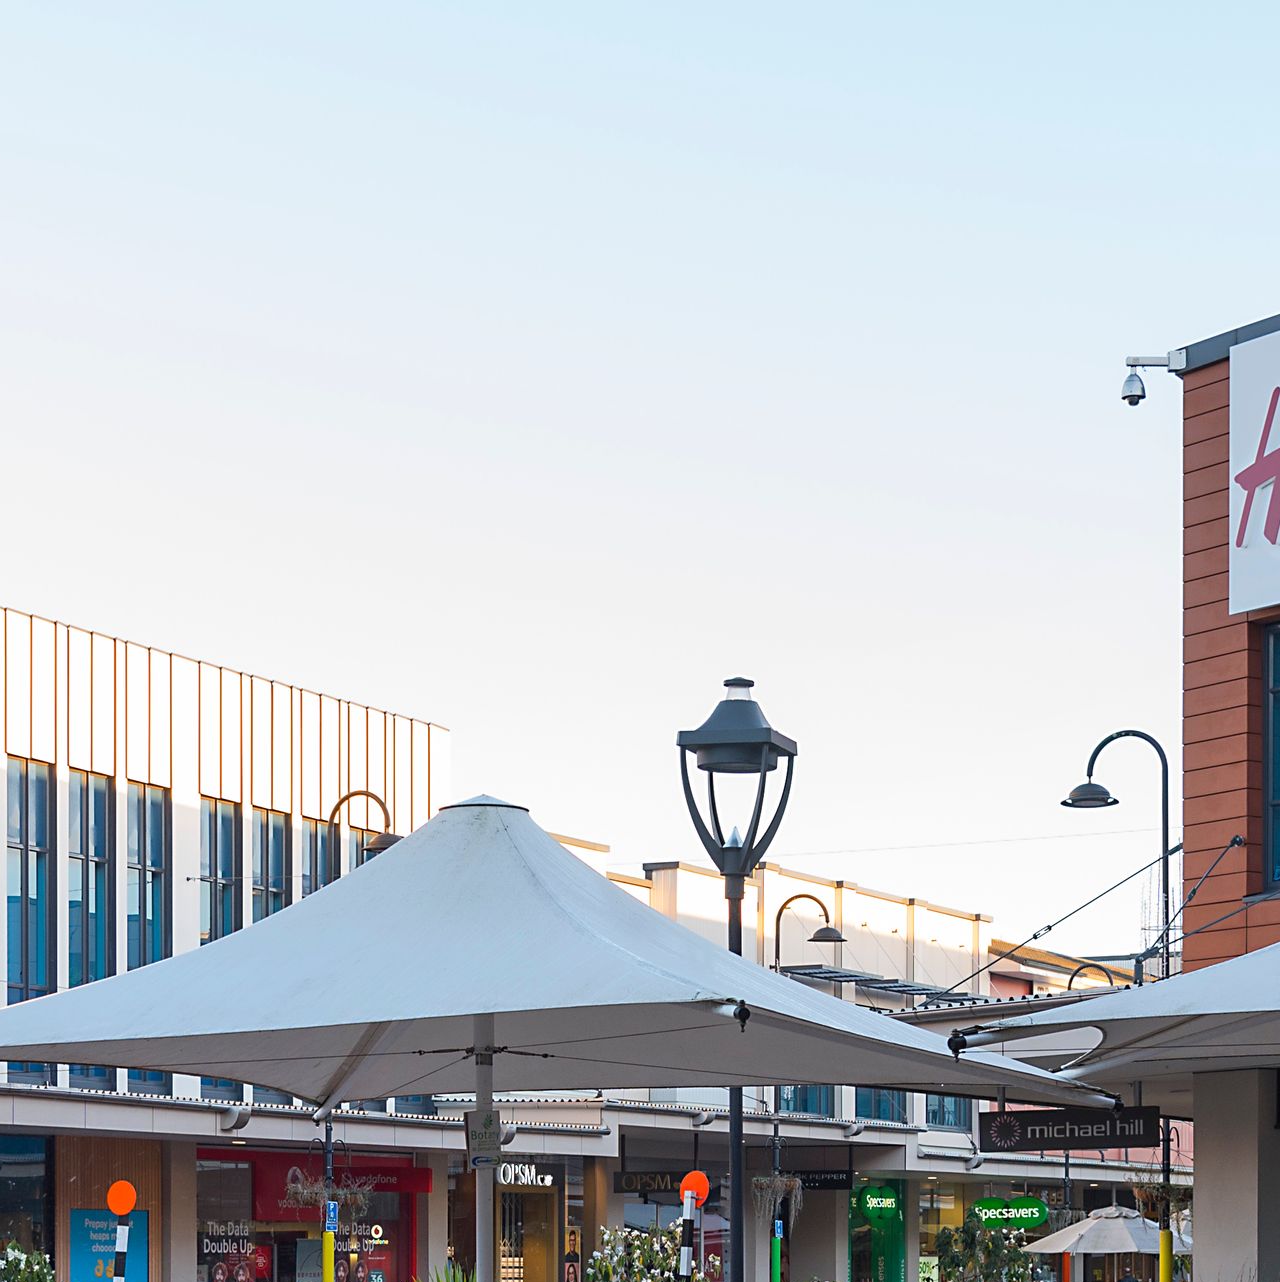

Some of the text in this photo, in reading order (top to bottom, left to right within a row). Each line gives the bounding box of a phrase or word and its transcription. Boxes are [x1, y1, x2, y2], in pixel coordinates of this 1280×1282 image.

[1027, 1119, 1144, 1139] michael hill
[497, 1163, 536, 1185] OPSM
[622, 1173, 671, 1190] OPSM
[866, 1195, 896, 1209] Specsavers
[207, 1221, 249, 1236] The Data
[352, 1222, 371, 1236] Data
[203, 1239, 237, 1253] Double
[363, 1238, 374, 1255] Up
